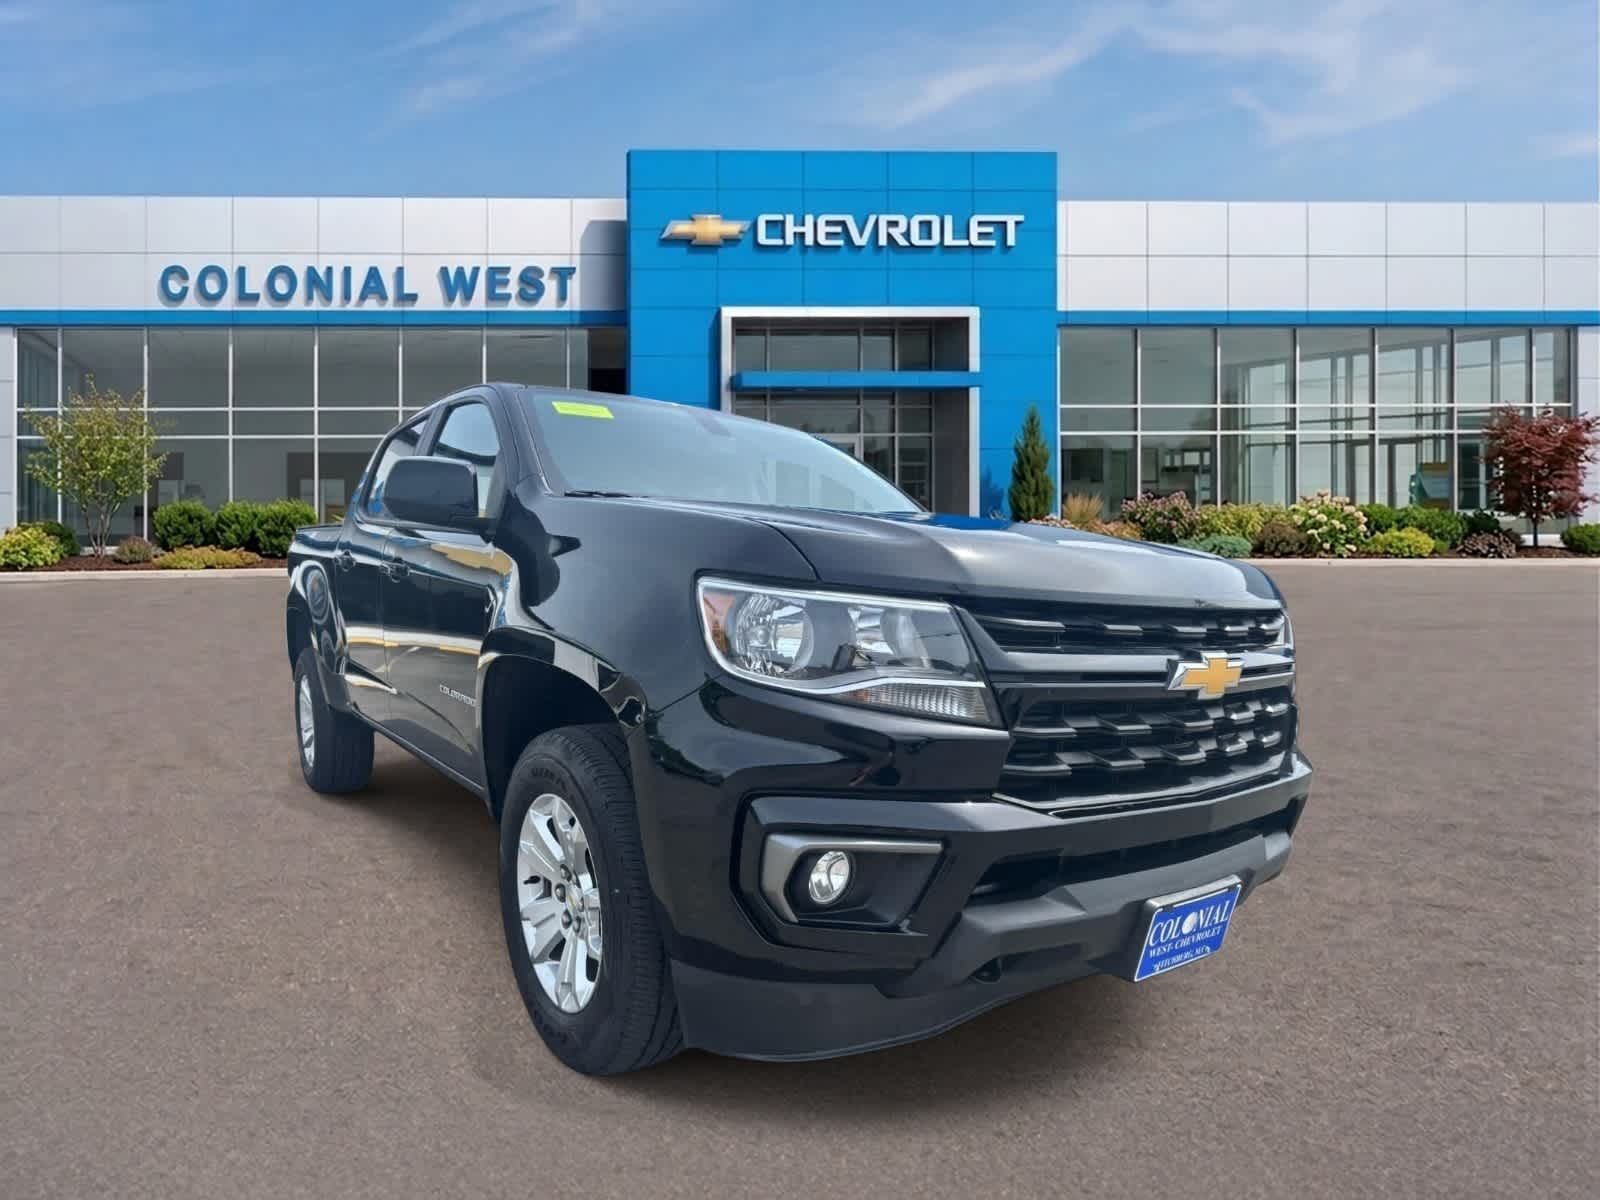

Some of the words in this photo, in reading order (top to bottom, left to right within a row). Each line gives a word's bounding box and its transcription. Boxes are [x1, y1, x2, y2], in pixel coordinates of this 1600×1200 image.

[756, 213, 1025, 247] CHEVROLET
[159, 264, 418, 303] COLONIAL
[439, 265, 577, 303] WEST
[439, 684, 477, 707] COLORADO
[1175, 925, 1223, 949] CHEVROLET
